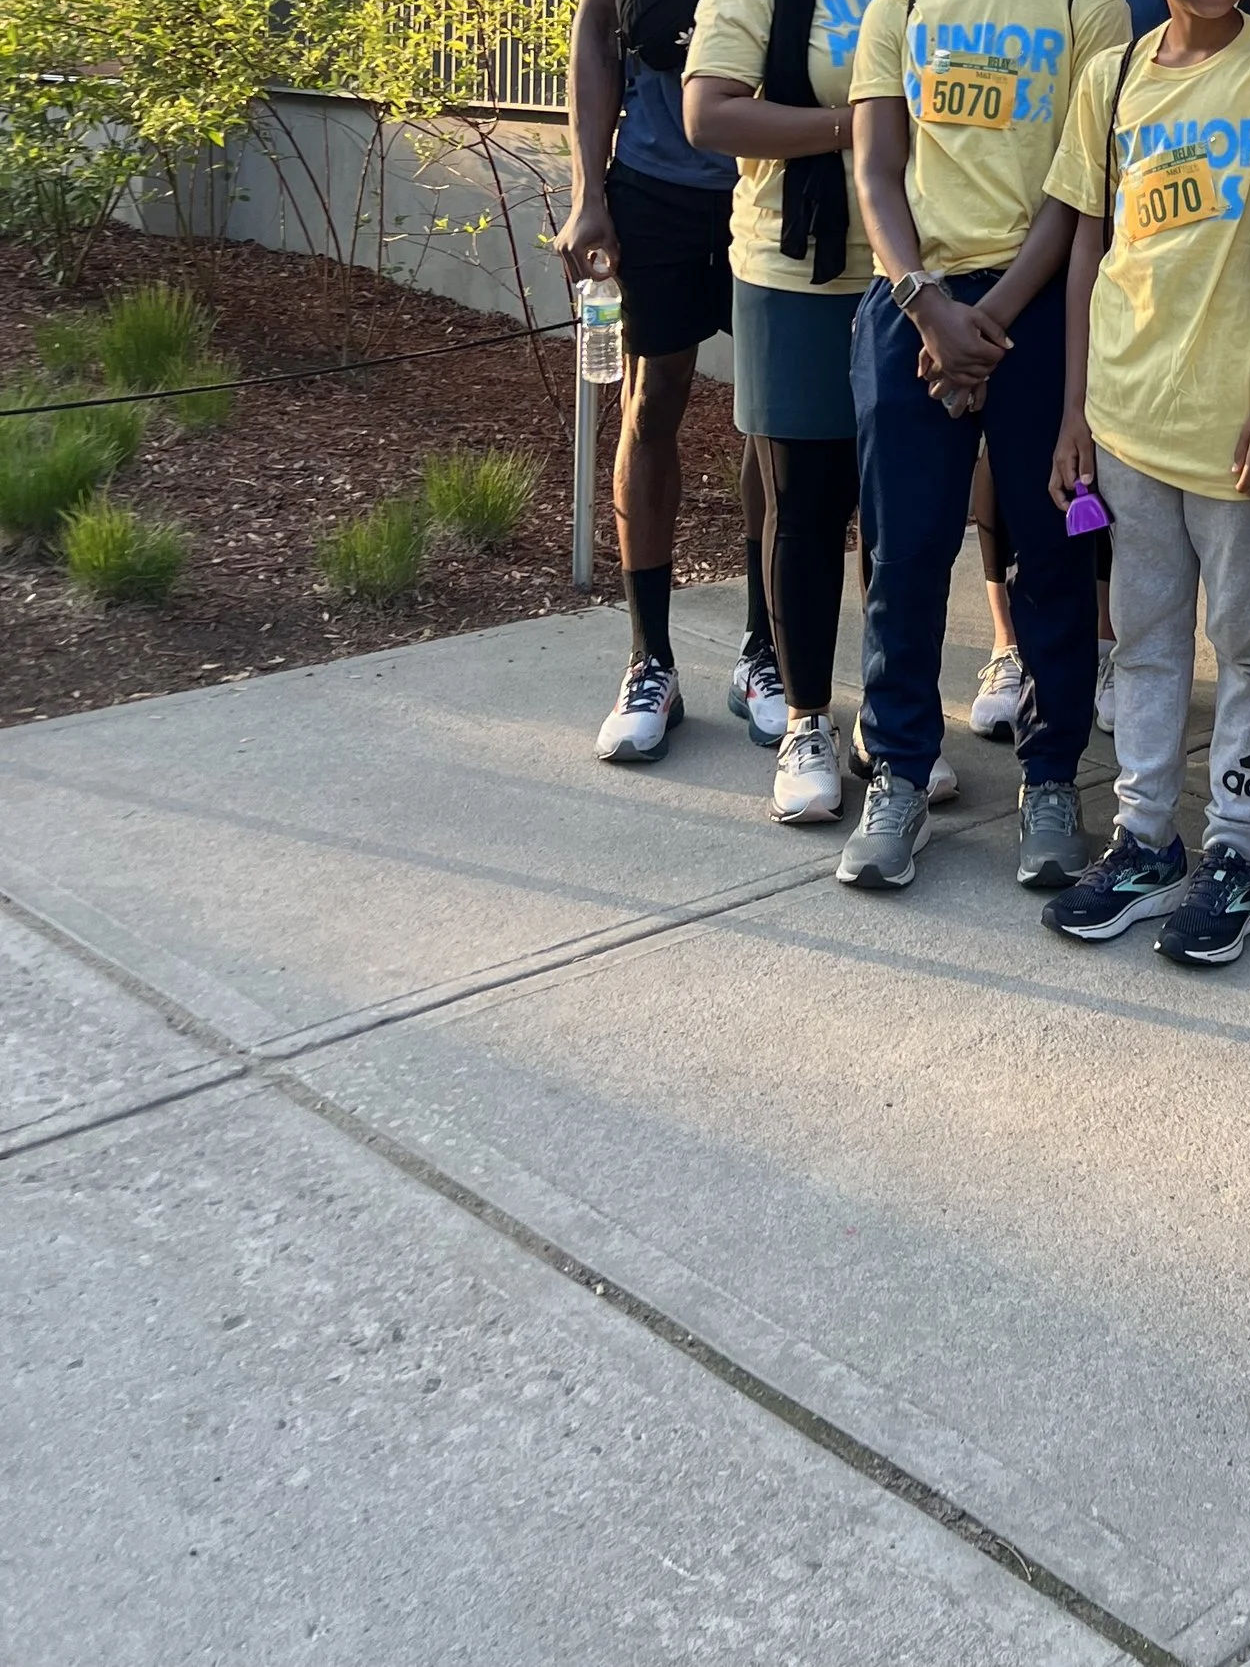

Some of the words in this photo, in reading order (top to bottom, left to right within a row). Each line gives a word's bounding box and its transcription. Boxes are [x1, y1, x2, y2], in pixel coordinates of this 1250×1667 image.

[988, 55, 1011, 71] RELAY
[932, 80, 1002, 120] 5070
[1172, 144, 1197, 162] RELAY
[1136, 177, 1201, 228] 5070
